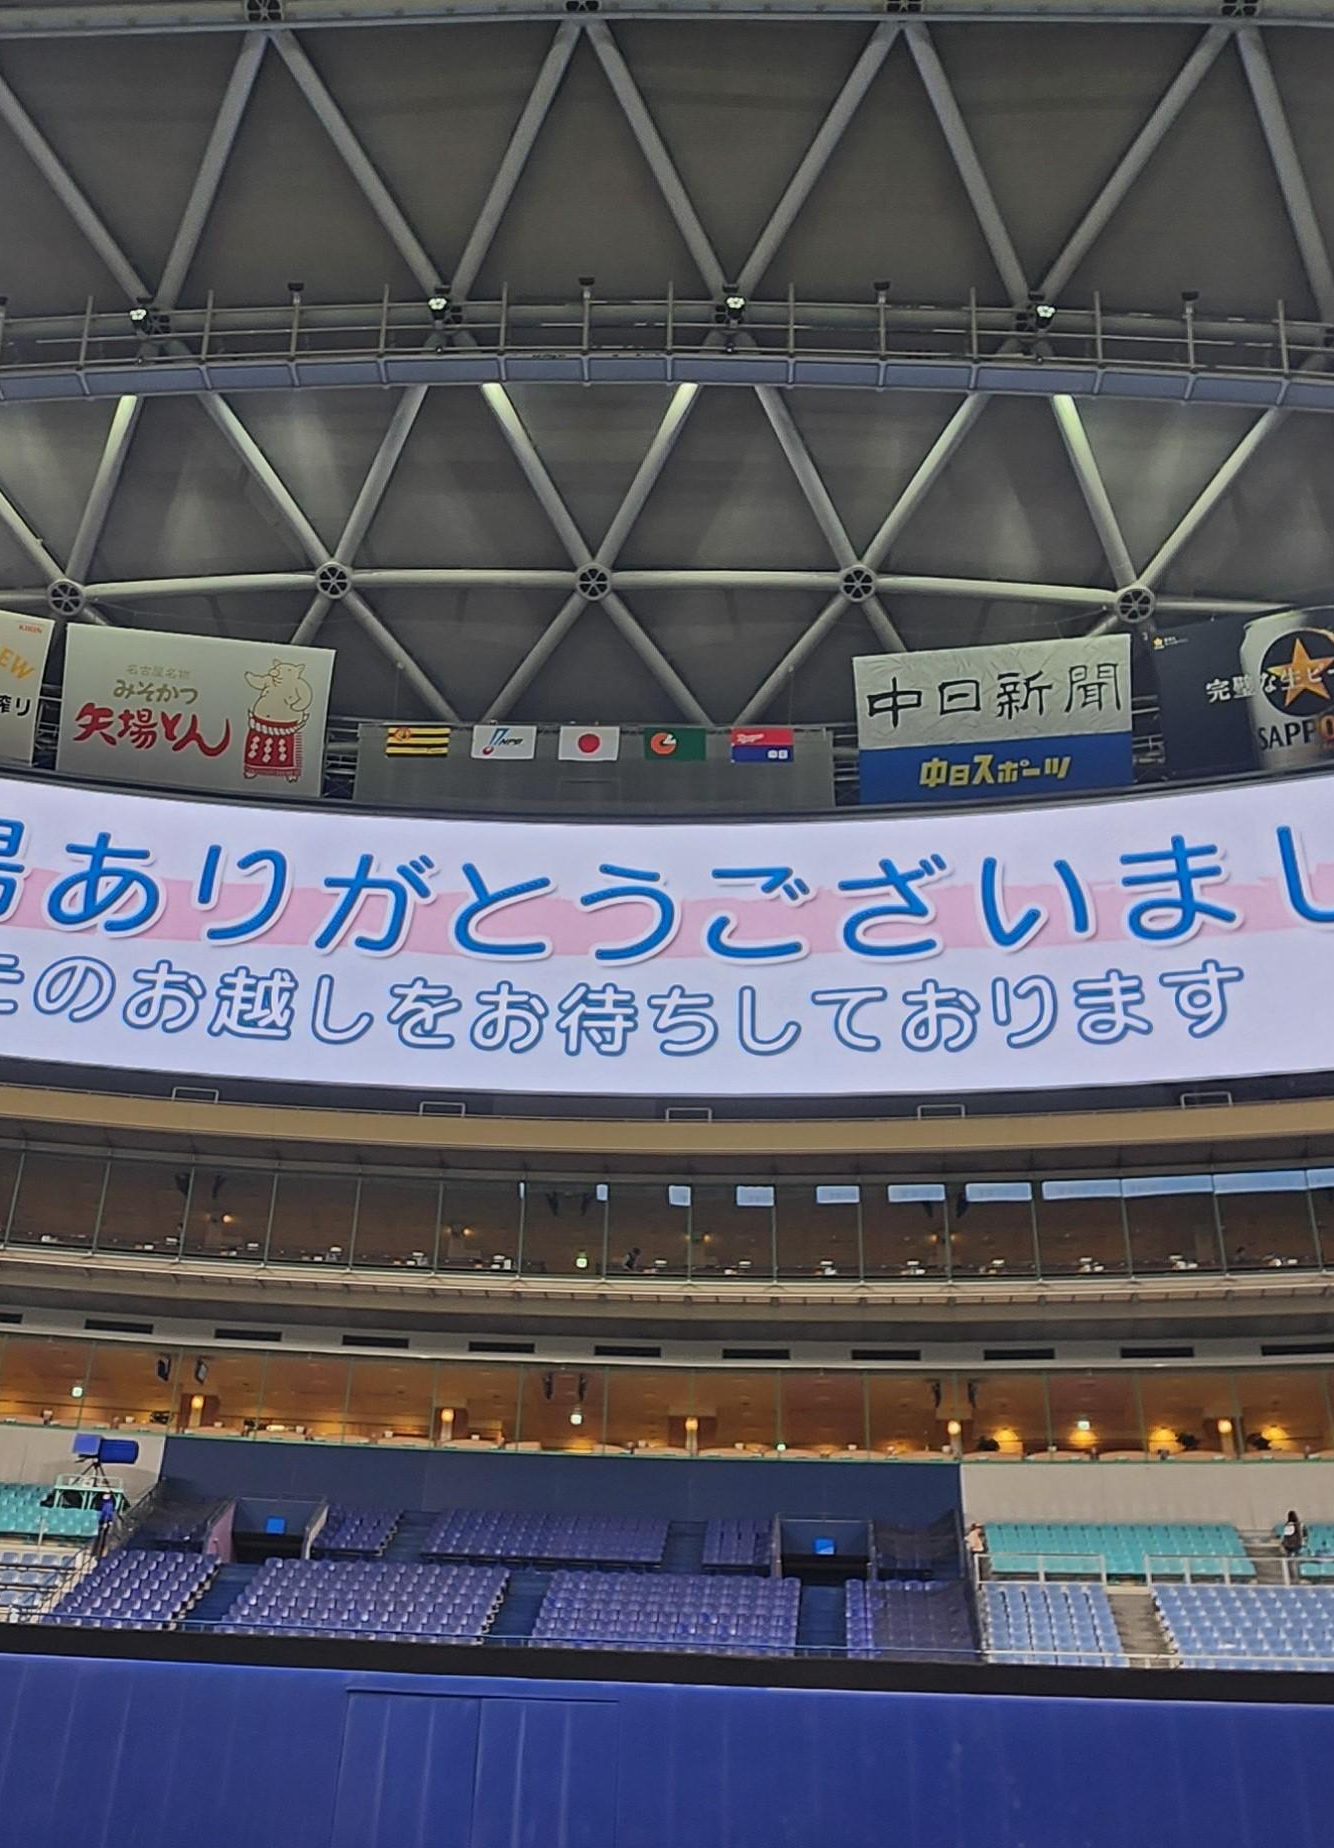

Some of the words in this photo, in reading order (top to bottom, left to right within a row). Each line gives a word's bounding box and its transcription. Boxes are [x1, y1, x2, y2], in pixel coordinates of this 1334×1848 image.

[113, 679, 199, 705] みそかつ
[867, 662, 1122, 728] 中日新聞
[72, 702, 231, 758] 矢場とん
[919, 754, 1071, 788] 中日スポーツ
